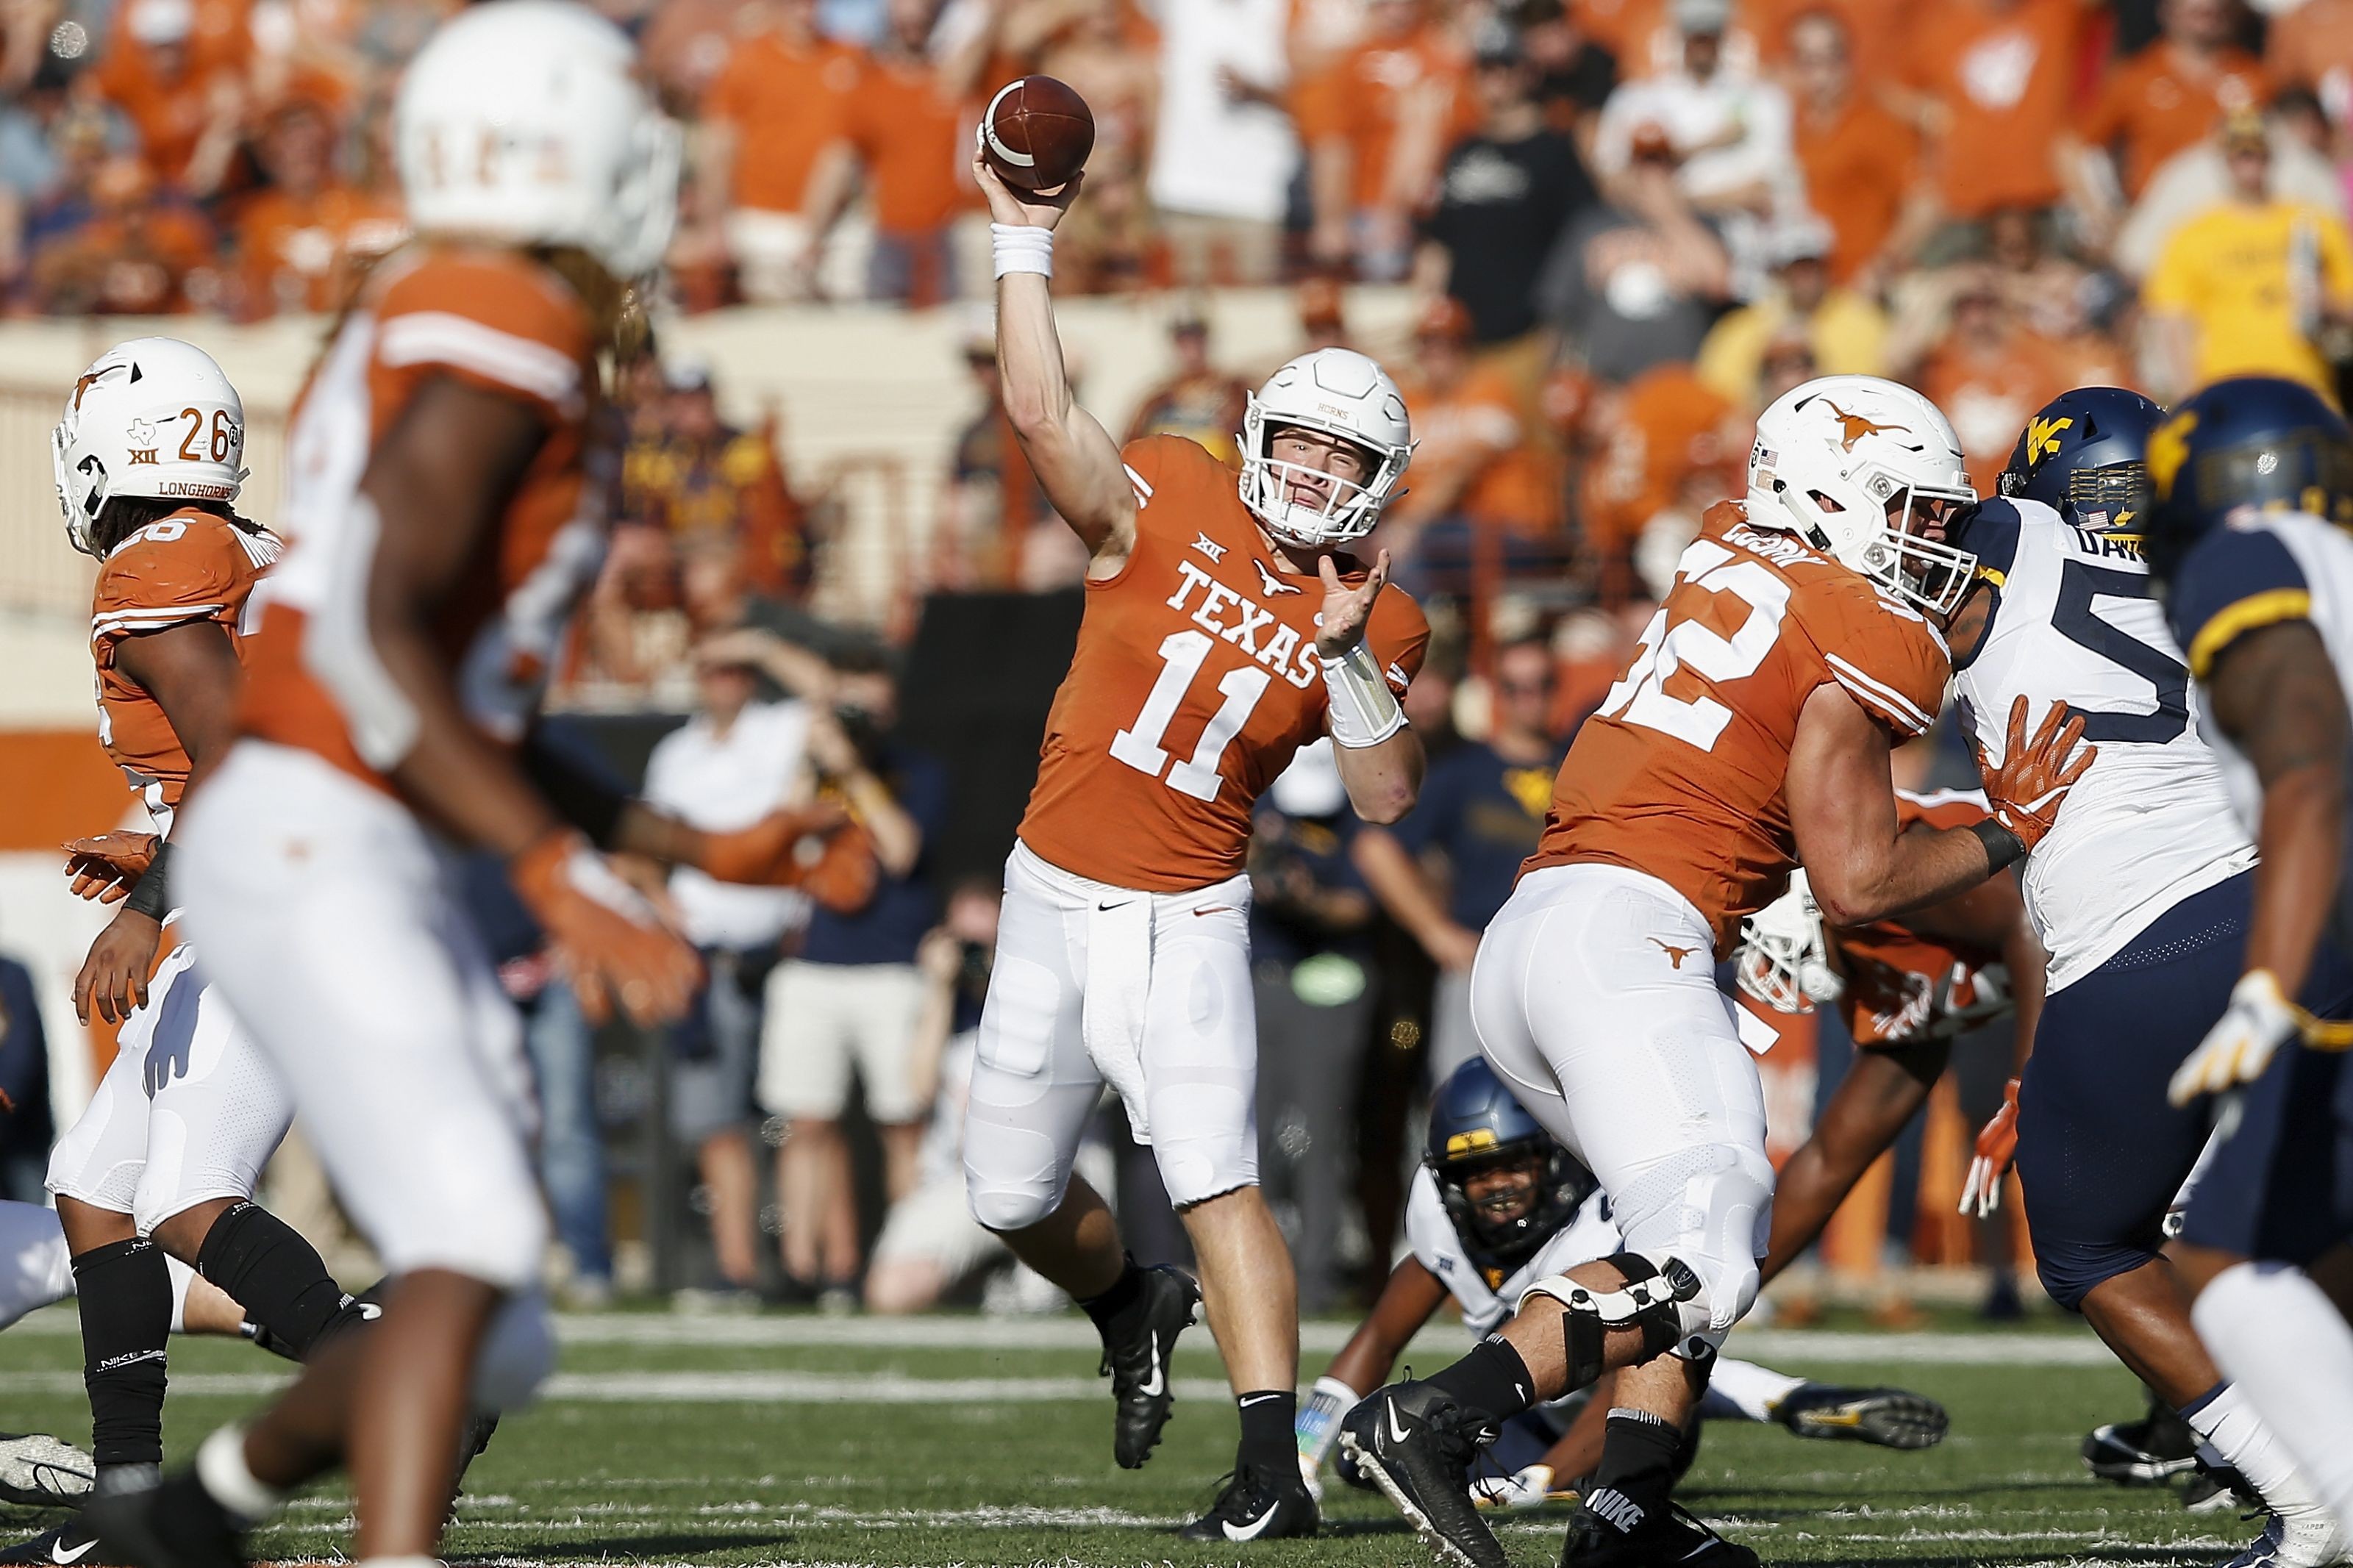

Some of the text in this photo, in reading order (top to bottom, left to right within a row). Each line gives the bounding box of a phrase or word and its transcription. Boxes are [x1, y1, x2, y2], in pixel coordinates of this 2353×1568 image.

[1318, 403, 1349, 420] HORNS
[179, 407, 229, 462] 26
[127, 448, 160, 465] XII
[159, 482, 234, 498] LONGHORNS
[1190, 531, 1228, 565] XII
[1166, 559, 1318, 690] TEXAS
[1108, 629, 1272, 803] 11
[1585, 1488, 1645, 1533] NIKE
